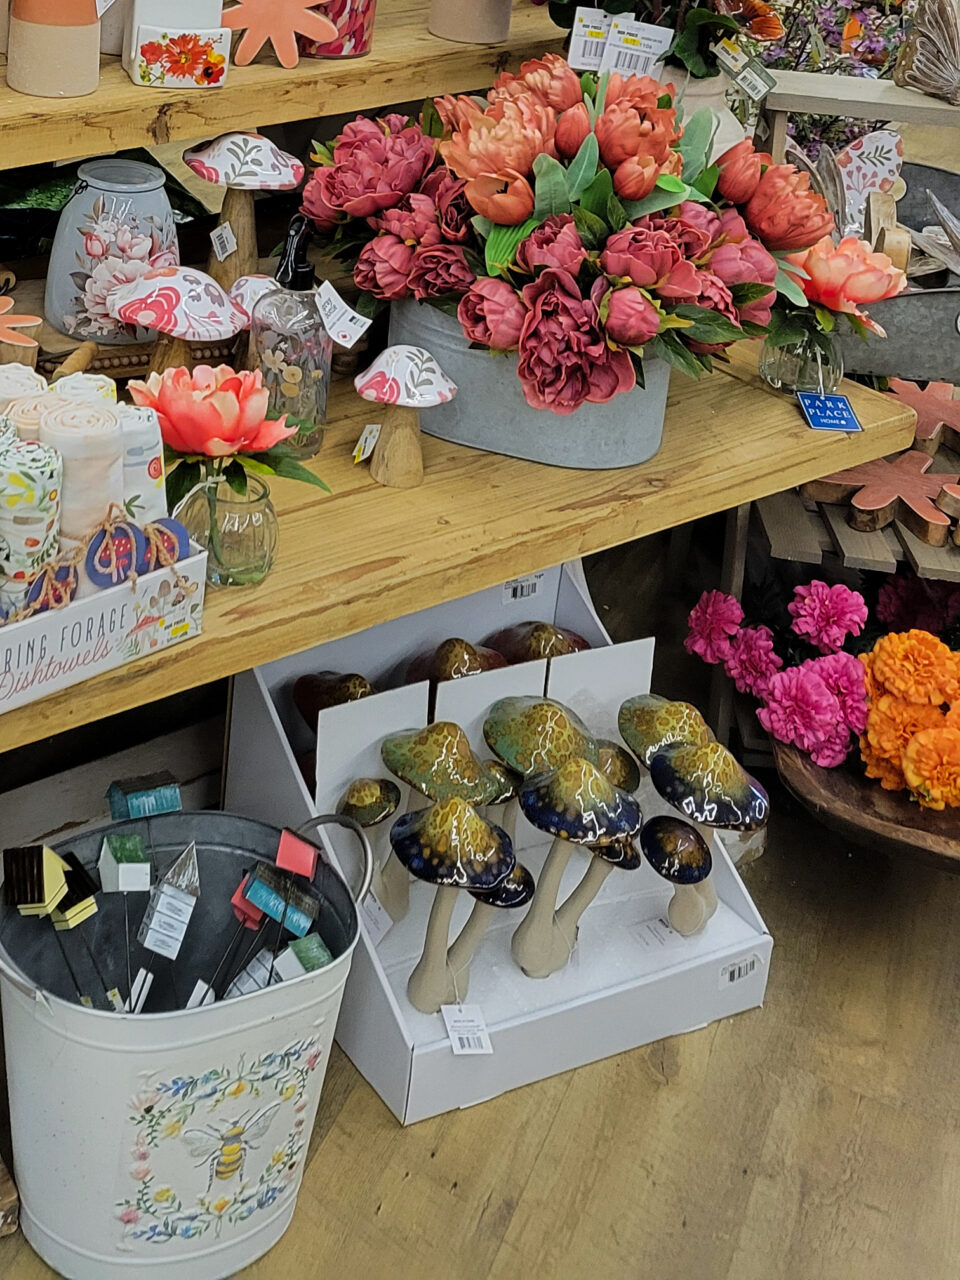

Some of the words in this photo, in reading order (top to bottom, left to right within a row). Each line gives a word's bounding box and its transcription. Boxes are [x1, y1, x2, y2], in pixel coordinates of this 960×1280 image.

[804, 398, 846, 409] PARK
[808, 408, 851, 418] PLACE
[59, 603, 128, 651] FORAGE
